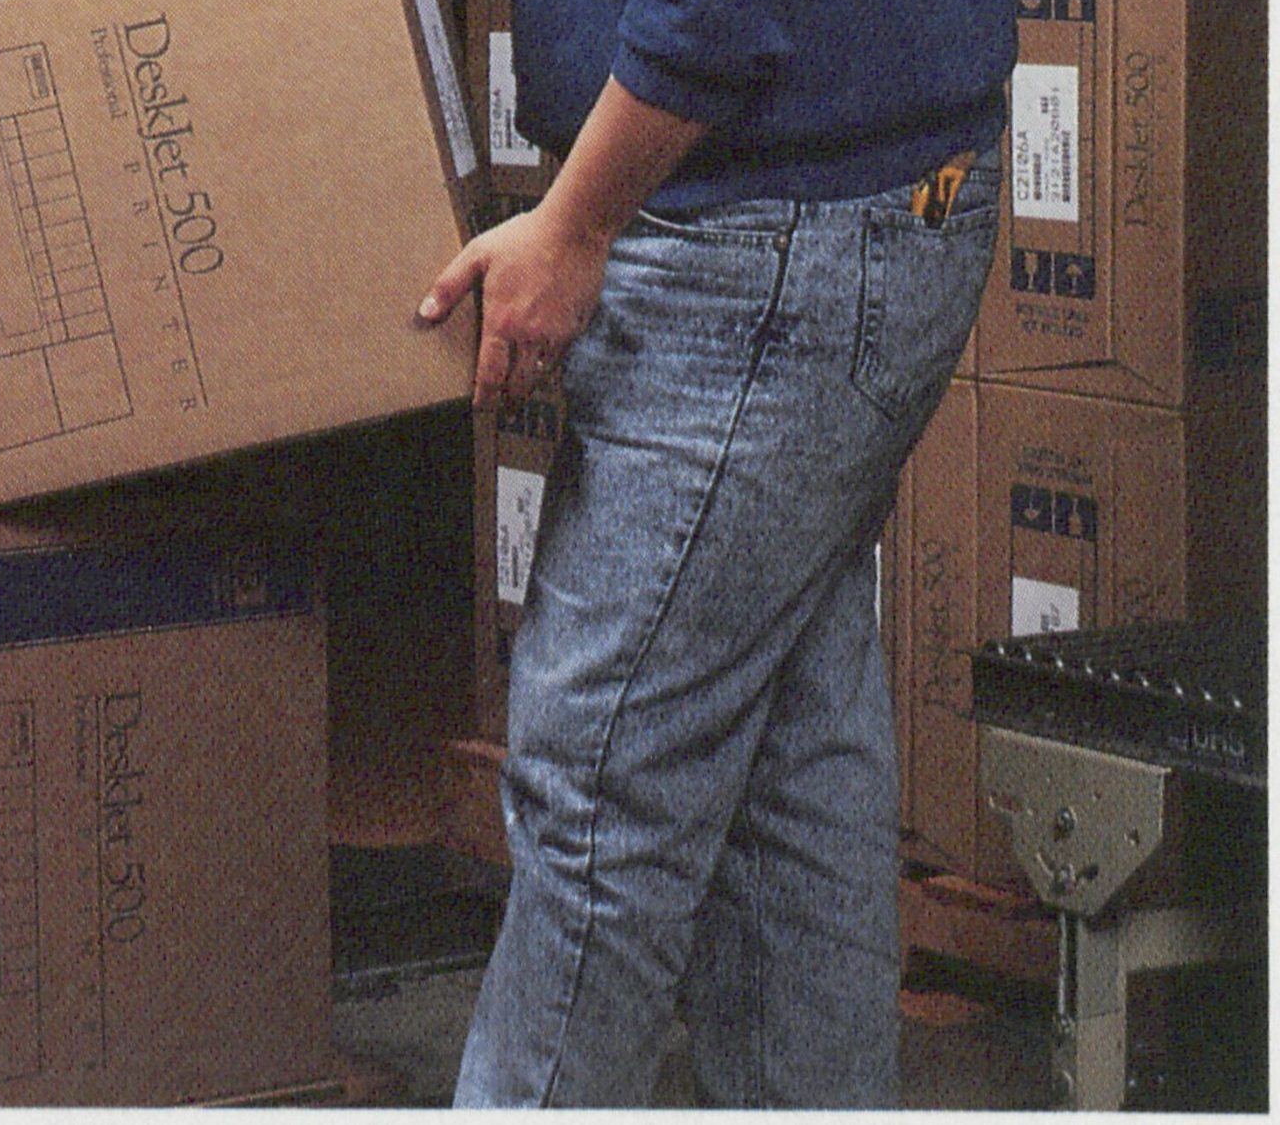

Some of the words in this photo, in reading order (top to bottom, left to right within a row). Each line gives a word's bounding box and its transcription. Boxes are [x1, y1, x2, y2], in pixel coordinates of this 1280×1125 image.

[1125, 51, 1152, 106] 500
[124, 12, 193, 181] DeskJet
[165, 192, 224, 275] 500
[1016, 130, 1030, 201] C2106A
[123, 160, 198, 412] PRINTER
[101, 690, 144, 847] DeskJet
[107, 862, 145, 942] 500
